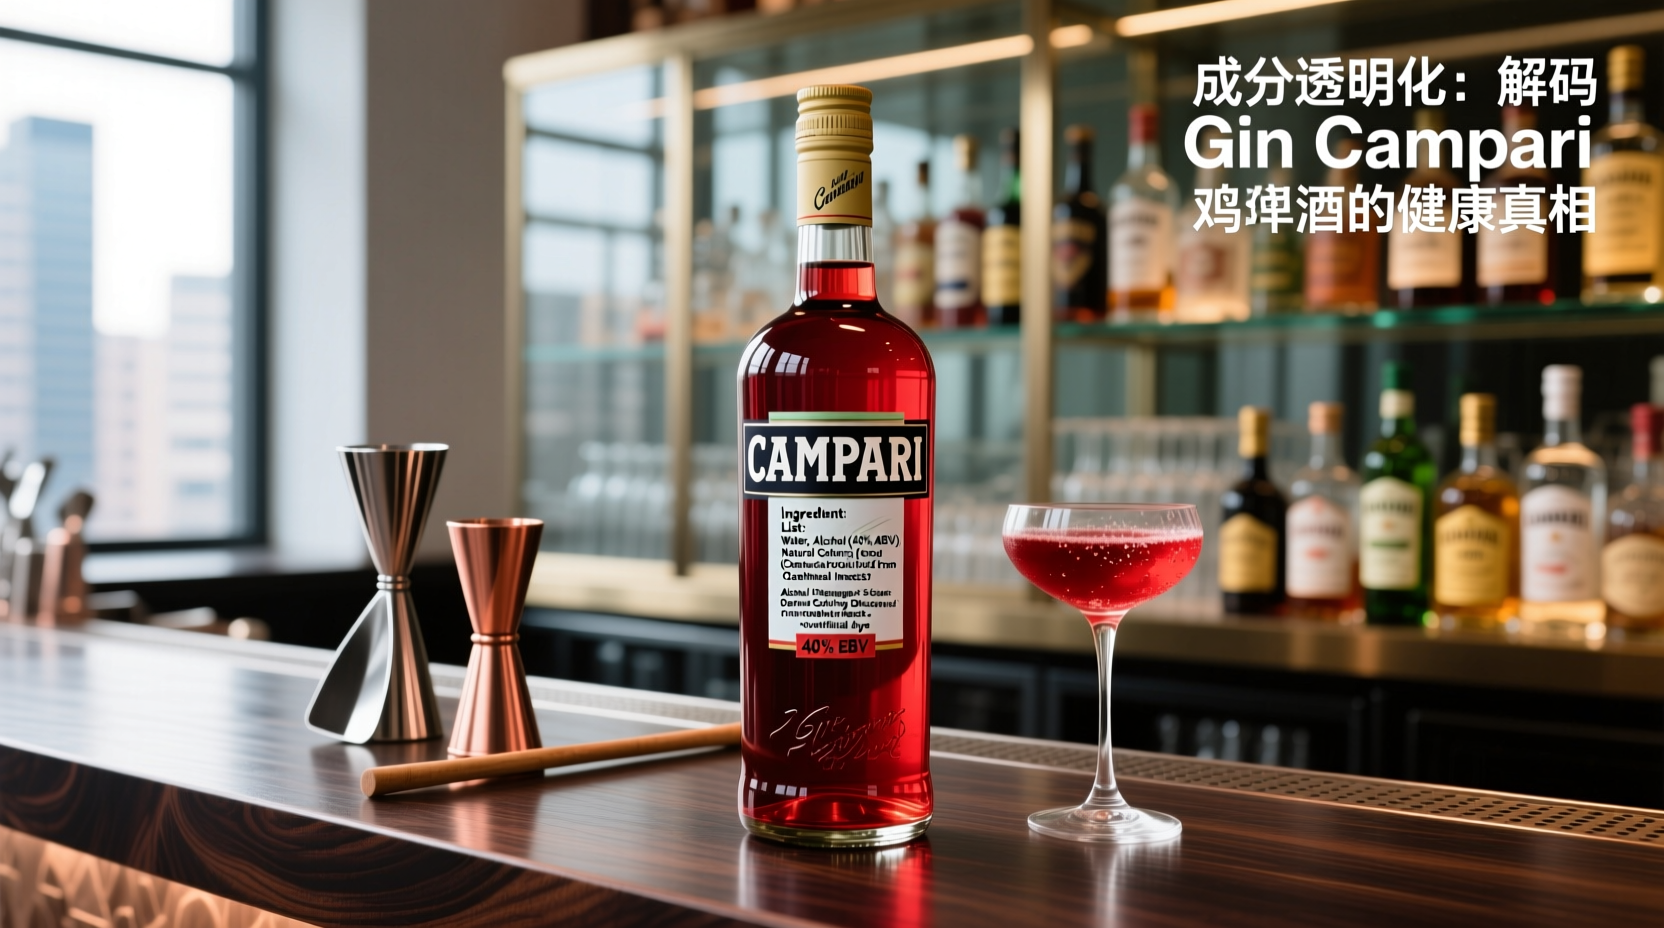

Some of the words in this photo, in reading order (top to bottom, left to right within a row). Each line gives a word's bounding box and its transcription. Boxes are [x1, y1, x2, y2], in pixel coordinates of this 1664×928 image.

[747, 434, 922, 483] CAMPARI
[801, 638, 834, 654] 40%
[838, 638, 869, 654] EBV
